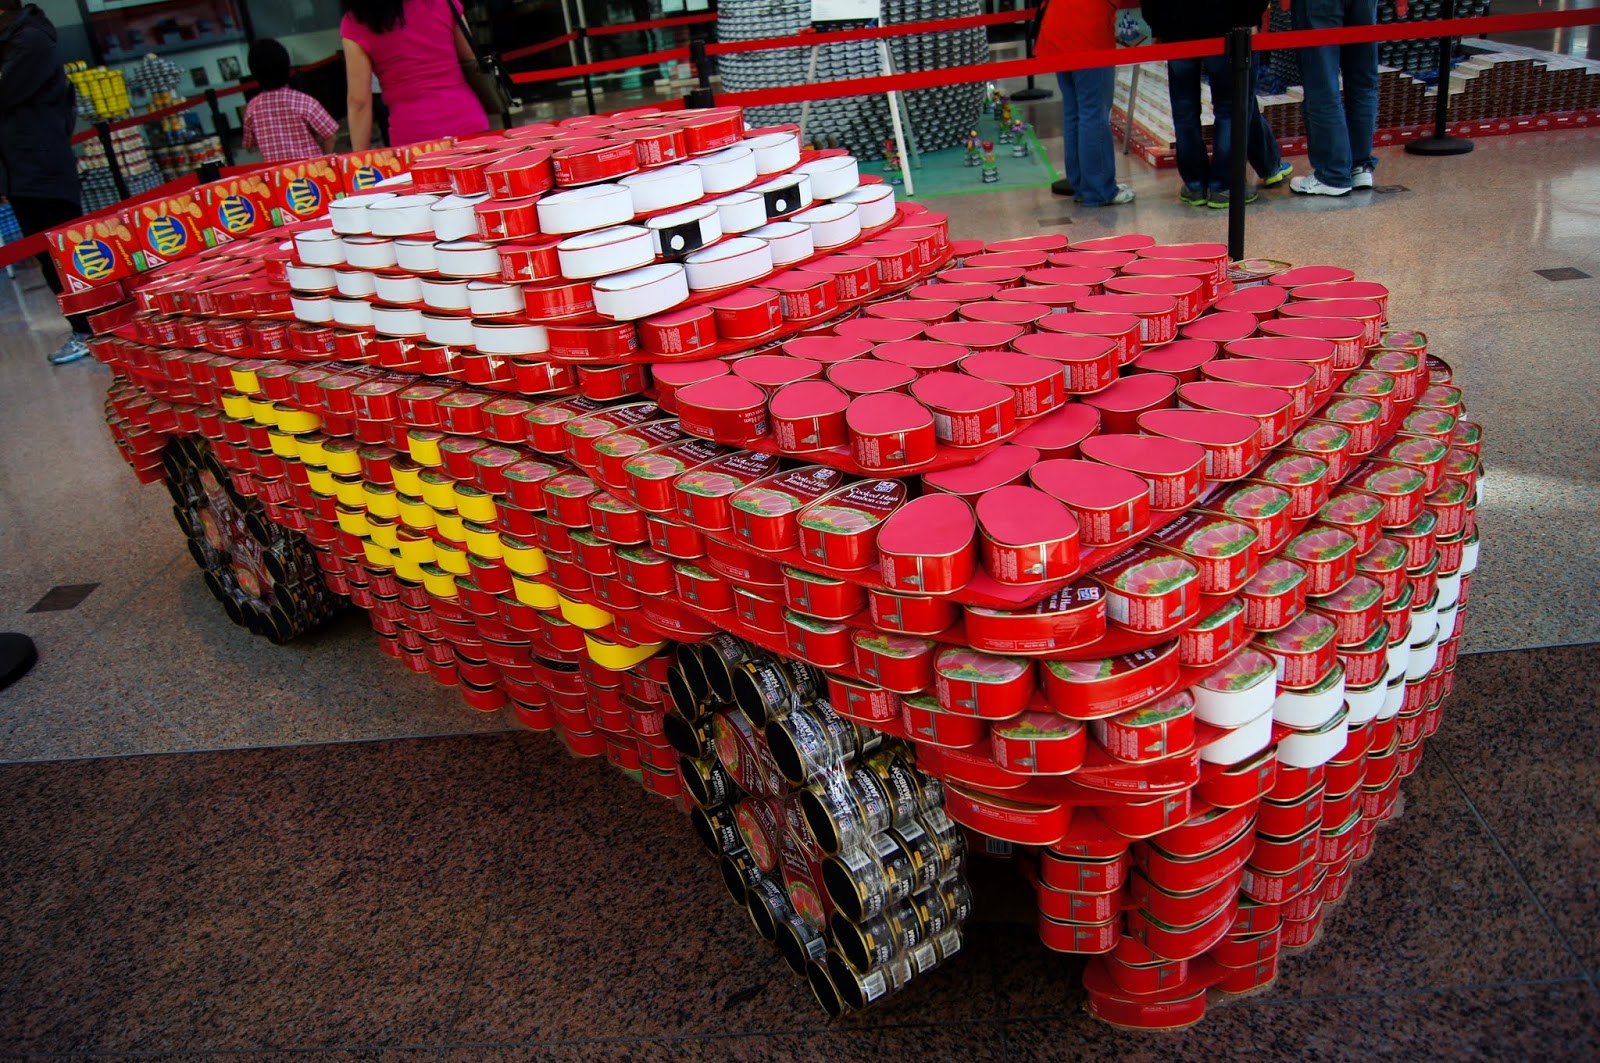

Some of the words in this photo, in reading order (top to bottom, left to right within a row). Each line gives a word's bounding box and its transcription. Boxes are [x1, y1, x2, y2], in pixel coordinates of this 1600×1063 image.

[355, 167, 377, 190] ITZ
[288, 179, 320, 214] RITZ
[220, 196, 255, 232] RITZ
[149, 216, 187, 255] RITZ
[74, 240, 115, 279] RITZ
[724, 459, 747, 469] Jambon
[729, 455, 752, 466] Cooked
[784, 476, 808, 488] Jambon
[790, 471, 813, 485] Cooked
[845, 491, 874, 502] Jambon
[849, 486, 879, 499] Cooked
[878, 493, 898, 502] Ham
[759, 671, 773, 691] Flakes
[764, 668, 779, 687] HAM
[791, 710, 814, 738] JAMBON
[713, 770, 726, 796] JAMBON
[855, 768, 880, 798] JAMBON
[857, 778, 873, 801] Flocons
[892, 766, 912, 801] JAMBON
[892, 778, 906, 803] Flocons
[725, 825, 735, 842] HAM
